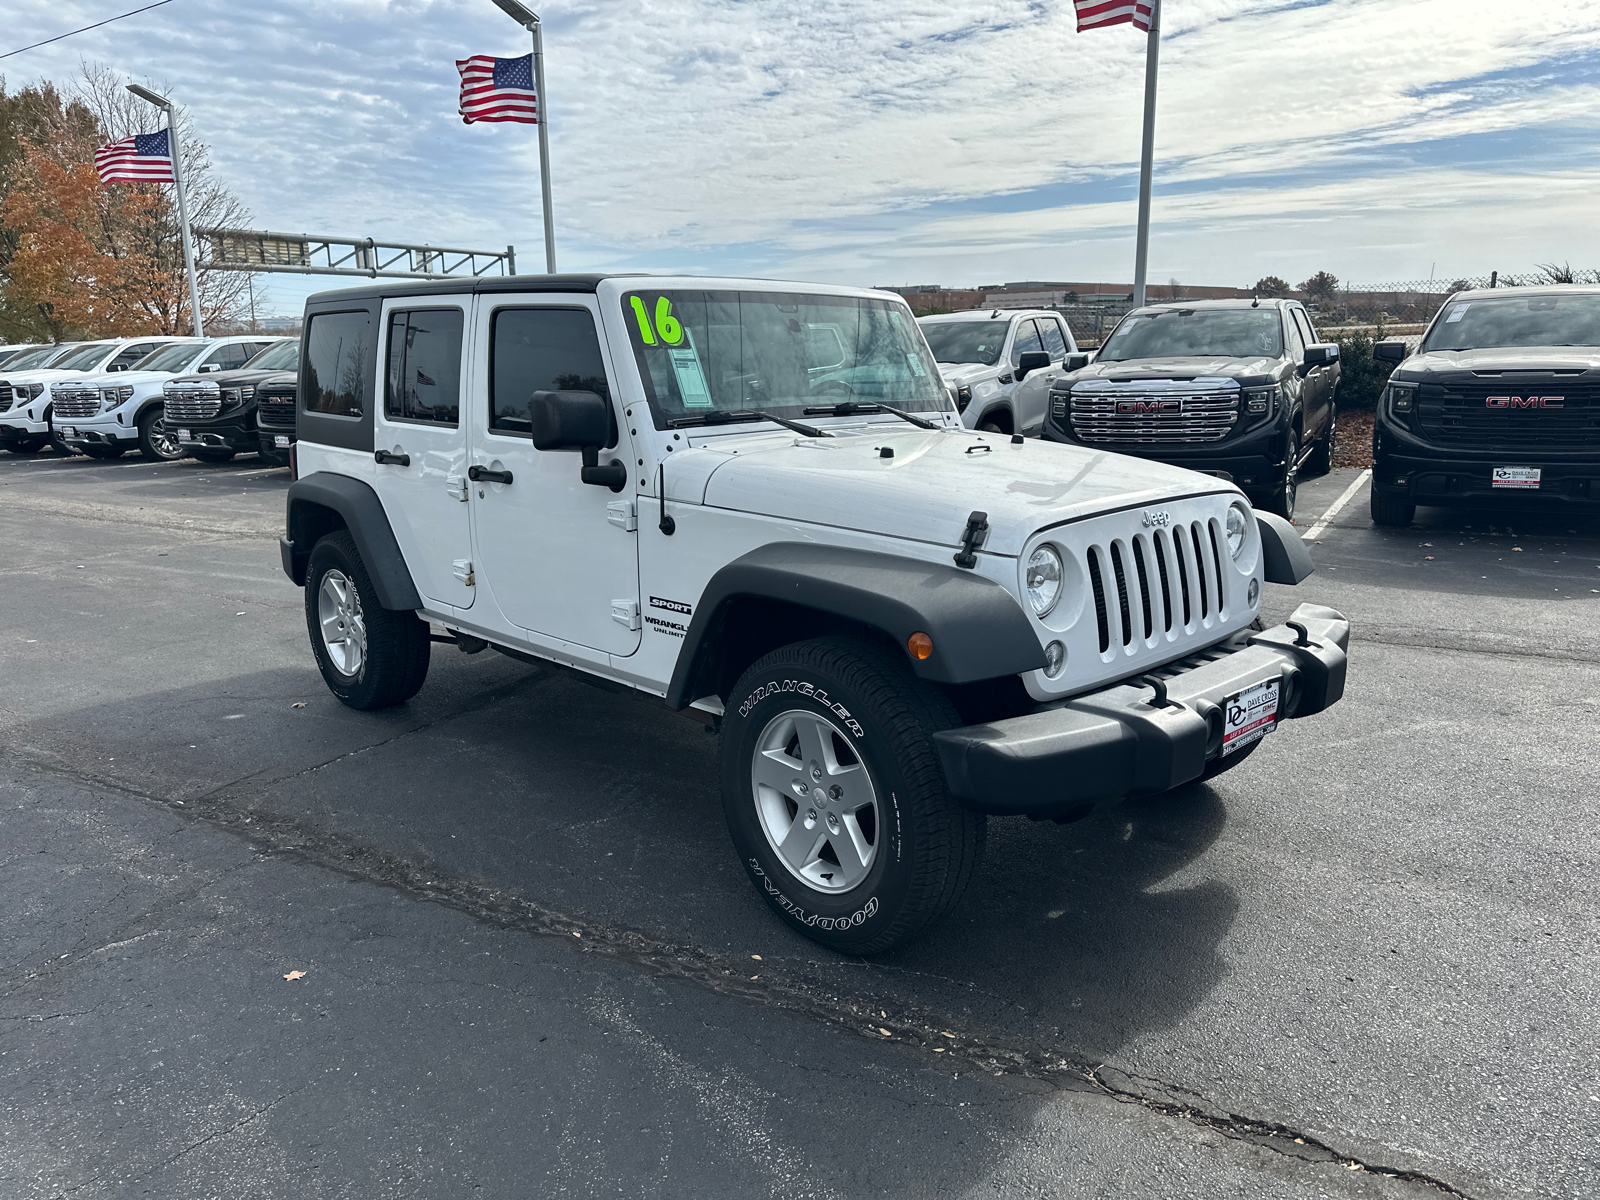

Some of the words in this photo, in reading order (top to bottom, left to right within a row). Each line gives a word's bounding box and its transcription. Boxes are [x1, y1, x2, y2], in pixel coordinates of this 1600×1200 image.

[630, 296, 685, 346] 16
[1118, 402, 1179, 413] GMC
[1485, 396, 1565, 408] GMC
[1142, 510, 1170, 528] Jeep
[651, 598, 691, 614] SPORT
[644, 615, 689, 632] WRANGL
[653, 627, 685, 639] UNLIMIT
[1247, 697, 1261, 709] DAVE
[1261, 689, 1277, 702] CROSS
[738, 679, 865, 738] WRANGLER
[749, 857, 879, 931] GOODYEAR
